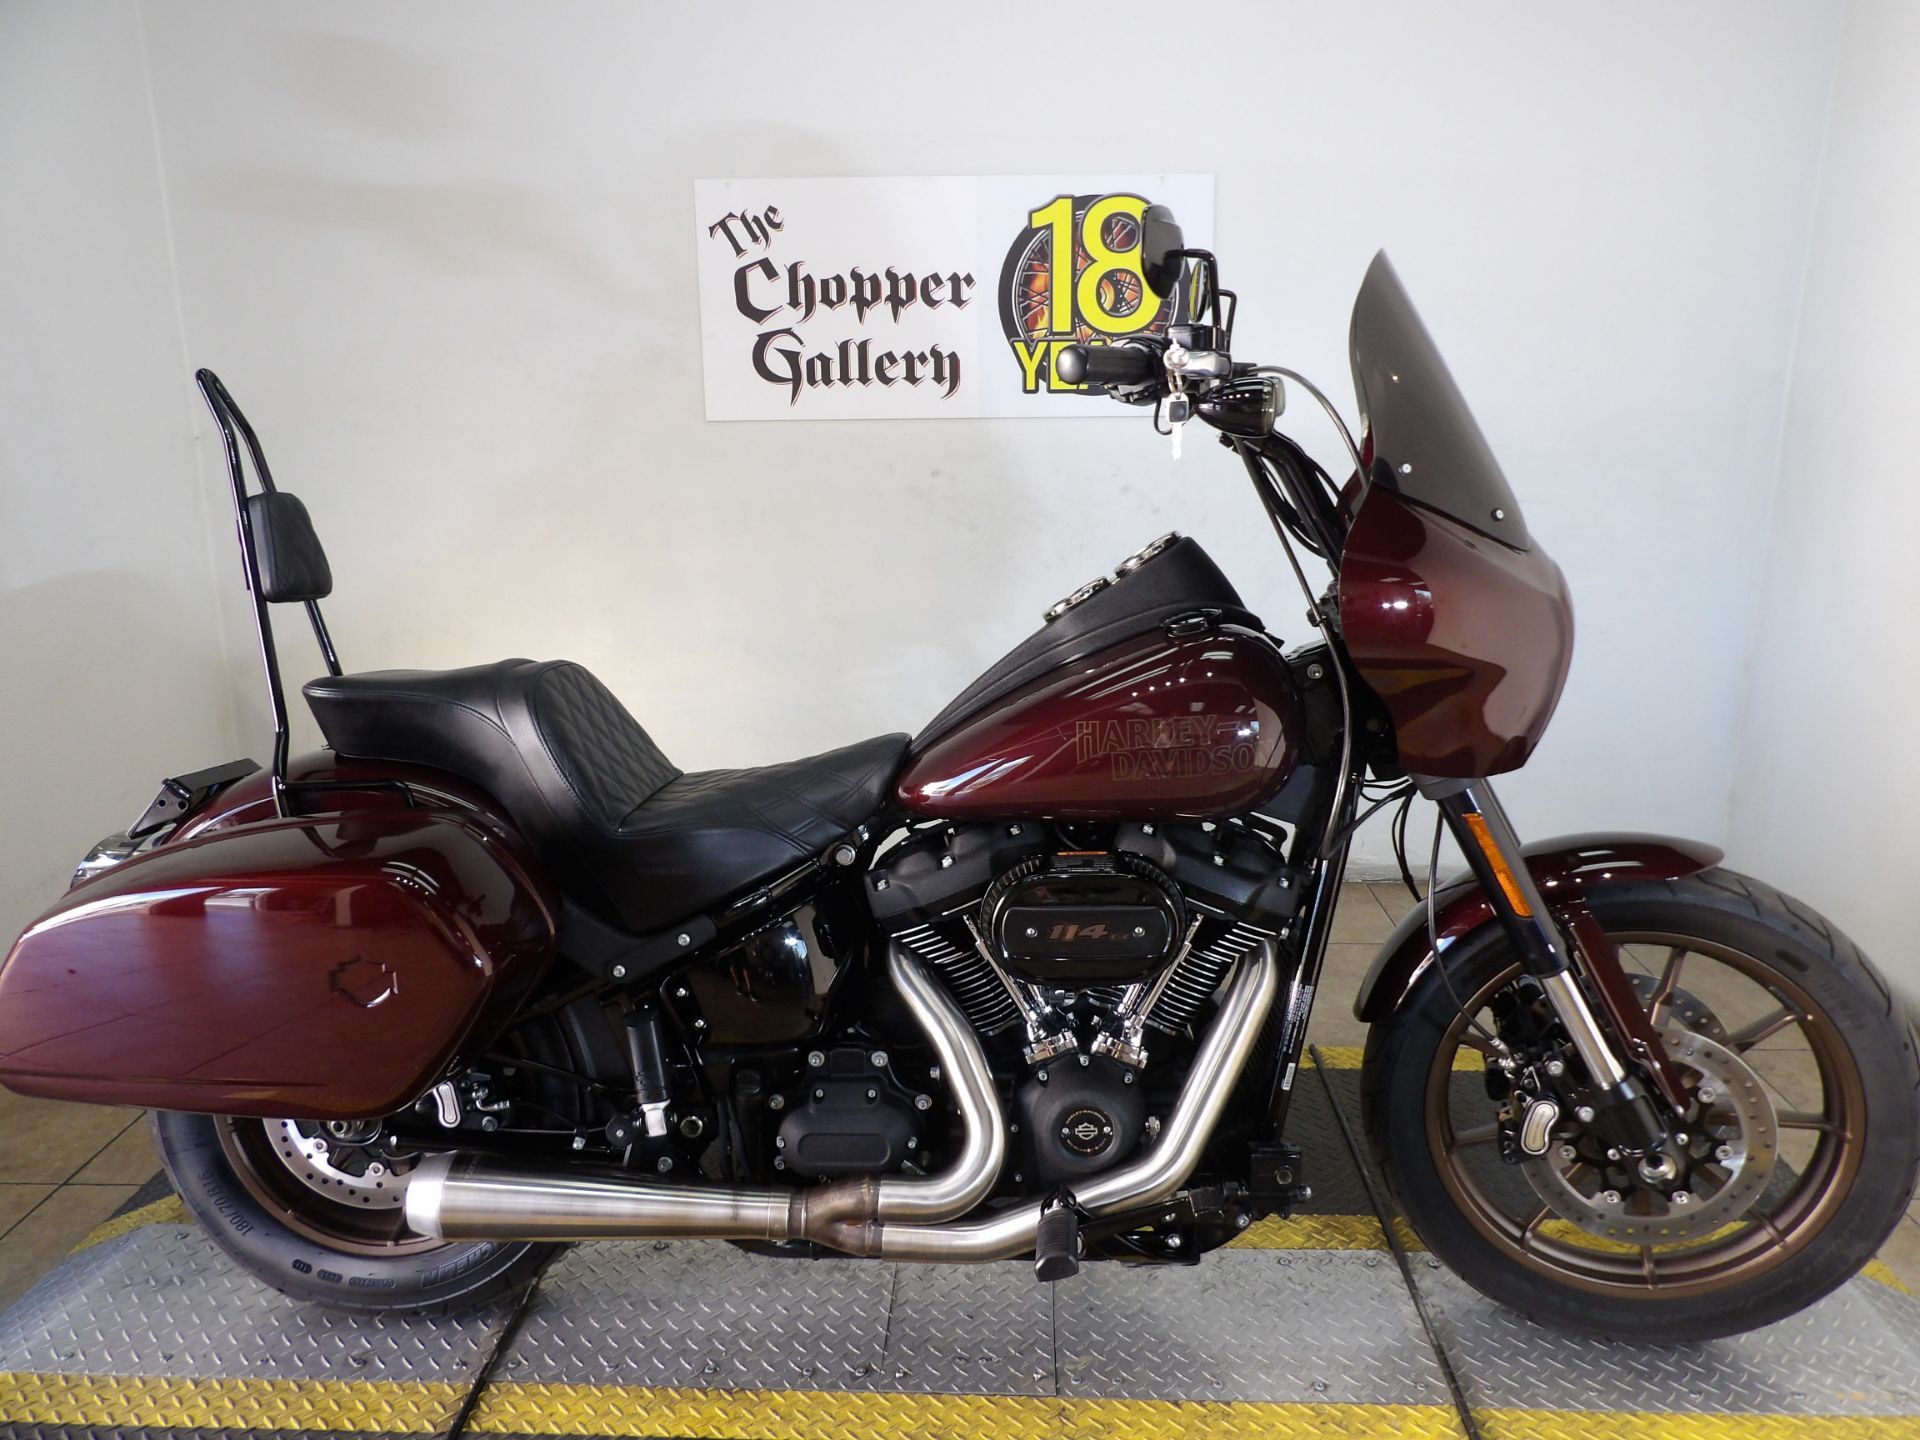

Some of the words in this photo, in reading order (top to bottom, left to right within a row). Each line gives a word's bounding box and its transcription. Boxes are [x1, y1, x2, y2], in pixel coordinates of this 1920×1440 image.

[708, 204, 785, 258] The
[1029, 194, 1171, 335] 18
[733, 256, 977, 326] Chopper
[751, 327, 961, 408] Gallery
[1048, 923, 1109, 943] 114
